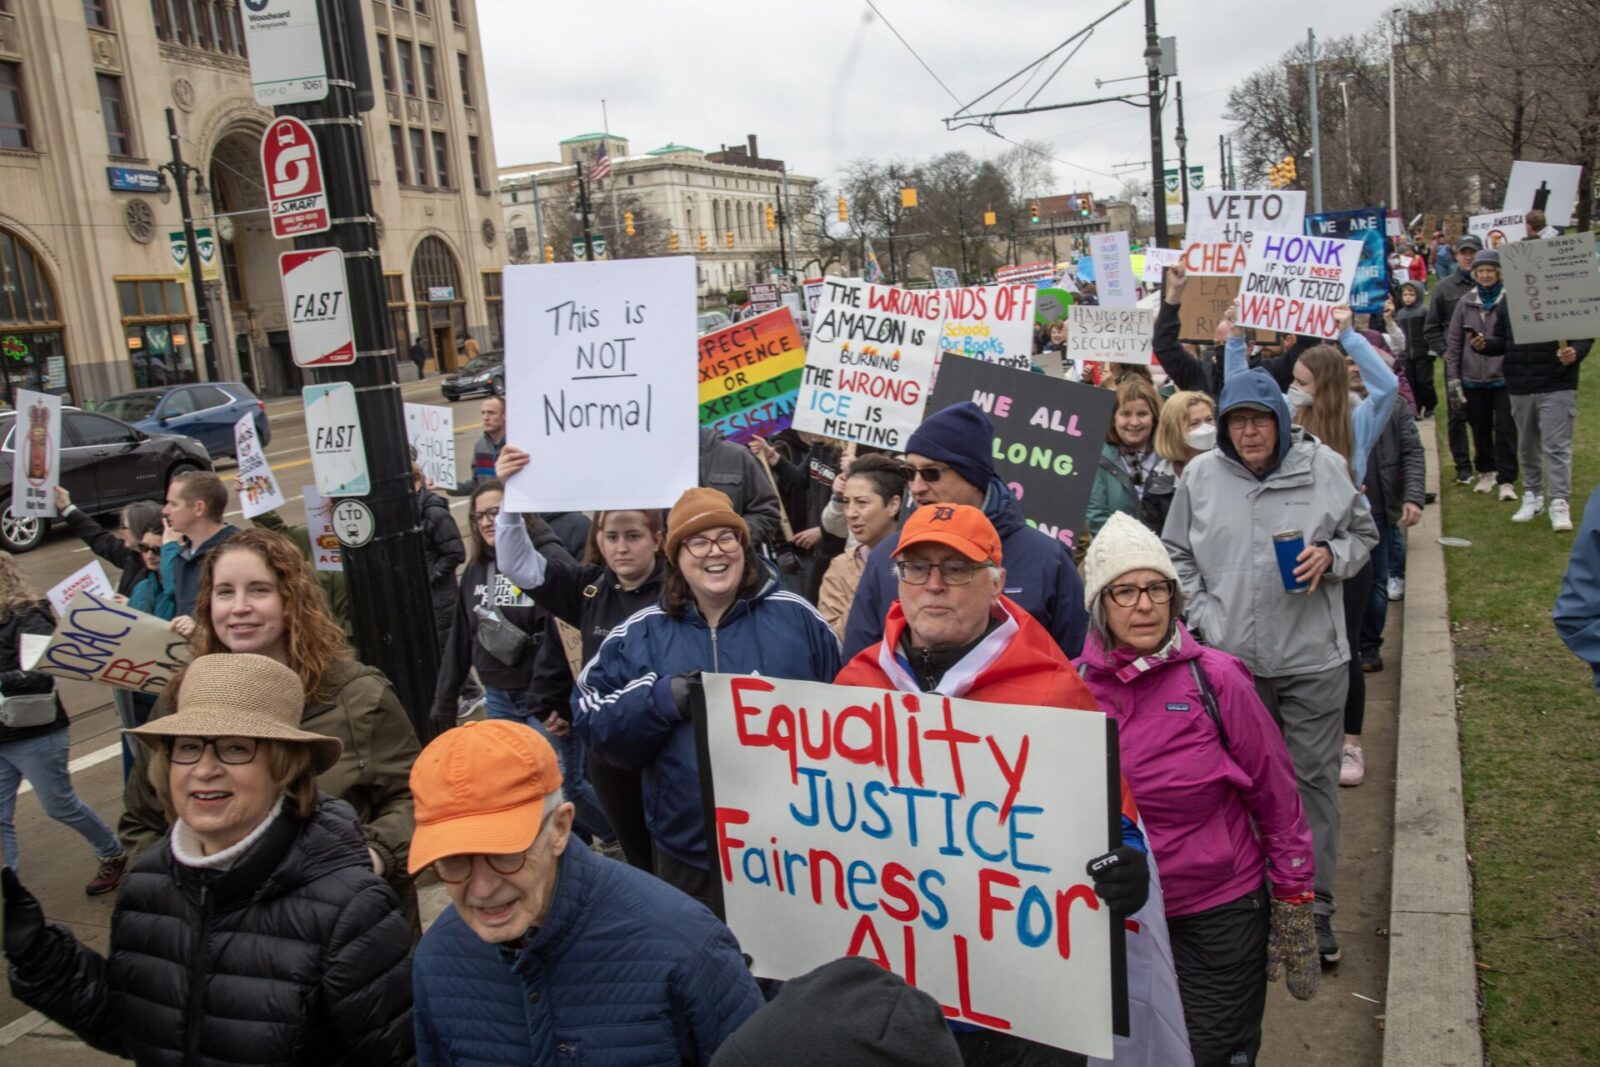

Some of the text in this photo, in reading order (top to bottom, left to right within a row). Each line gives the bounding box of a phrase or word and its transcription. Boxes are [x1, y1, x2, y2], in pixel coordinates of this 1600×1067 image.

[249, 11, 291, 22] Woodward
[302, 80, 322, 90] 1061
[278, 194, 322, 213] SMART
[1208, 194, 1283, 221] VETO
[1223, 222, 1253, 244] the
[1349, 216, 1378, 231] ARE
[1493, 215, 1523, 226] AMERICA
[1184, 243, 1252, 274] CHEA
[1264, 235, 1345, 267] HONK
[1266, 263, 1343, 280] IF YOU NEVER
[826, 281, 862, 309] THE
[868, 285, 940, 321] WRONG
[1246, 273, 1345, 303] DRUNK TEXTED
[293, 291, 343, 318] FAST
[995, 284, 1036, 321] OFF
[1074, 307, 1117, 322] HANDS
[1240, 294, 1338, 338] WAR PLANS
[545, 300, 646, 336] This is
[815, 309, 926, 346] AMAZON IS
[945, 322, 991, 337] Schools
[1079, 323, 1148, 336] SOCIAL
[1196, 316, 1221, 335] RI
[577, 338, 636, 372] NOT
[940, 336, 1004, 354] Our Books
[698, 336, 792, 384] XISTENCE
[840, 348, 900, 372] BURNING
[724, 372, 748, 391] OR
[805, 365, 920, 406] THE WRONG
[543, 384, 652, 436] Normal
[700, 376, 783, 423] XPECT
[810, 390, 883, 423] ICE IS
[972, 389, 1083, 437] WE ALL
[421, 407, 440, 432] NO
[706, 396, 798, 433] ESISTAN
[315, 425, 355, 449] FAST
[413, 432, 455, 461] K-HOLE
[824, 418, 899, 447] MELTING
[991, 437, 1078, 476] LONG.
[421, 460, 454, 485] KINGS
[338, 509, 363, 521] LTD
[474, 584, 512, 596] NOTH
[481, 596, 511, 606] FCE
[730, 678, 1031, 827] Equality
[789, 767, 1052, 874] JUSTICE
[1092, 854, 1119, 871] CTR
[716, 807, 1100, 960] Fairness For
[846, 914, 1012, 1030] ALL
